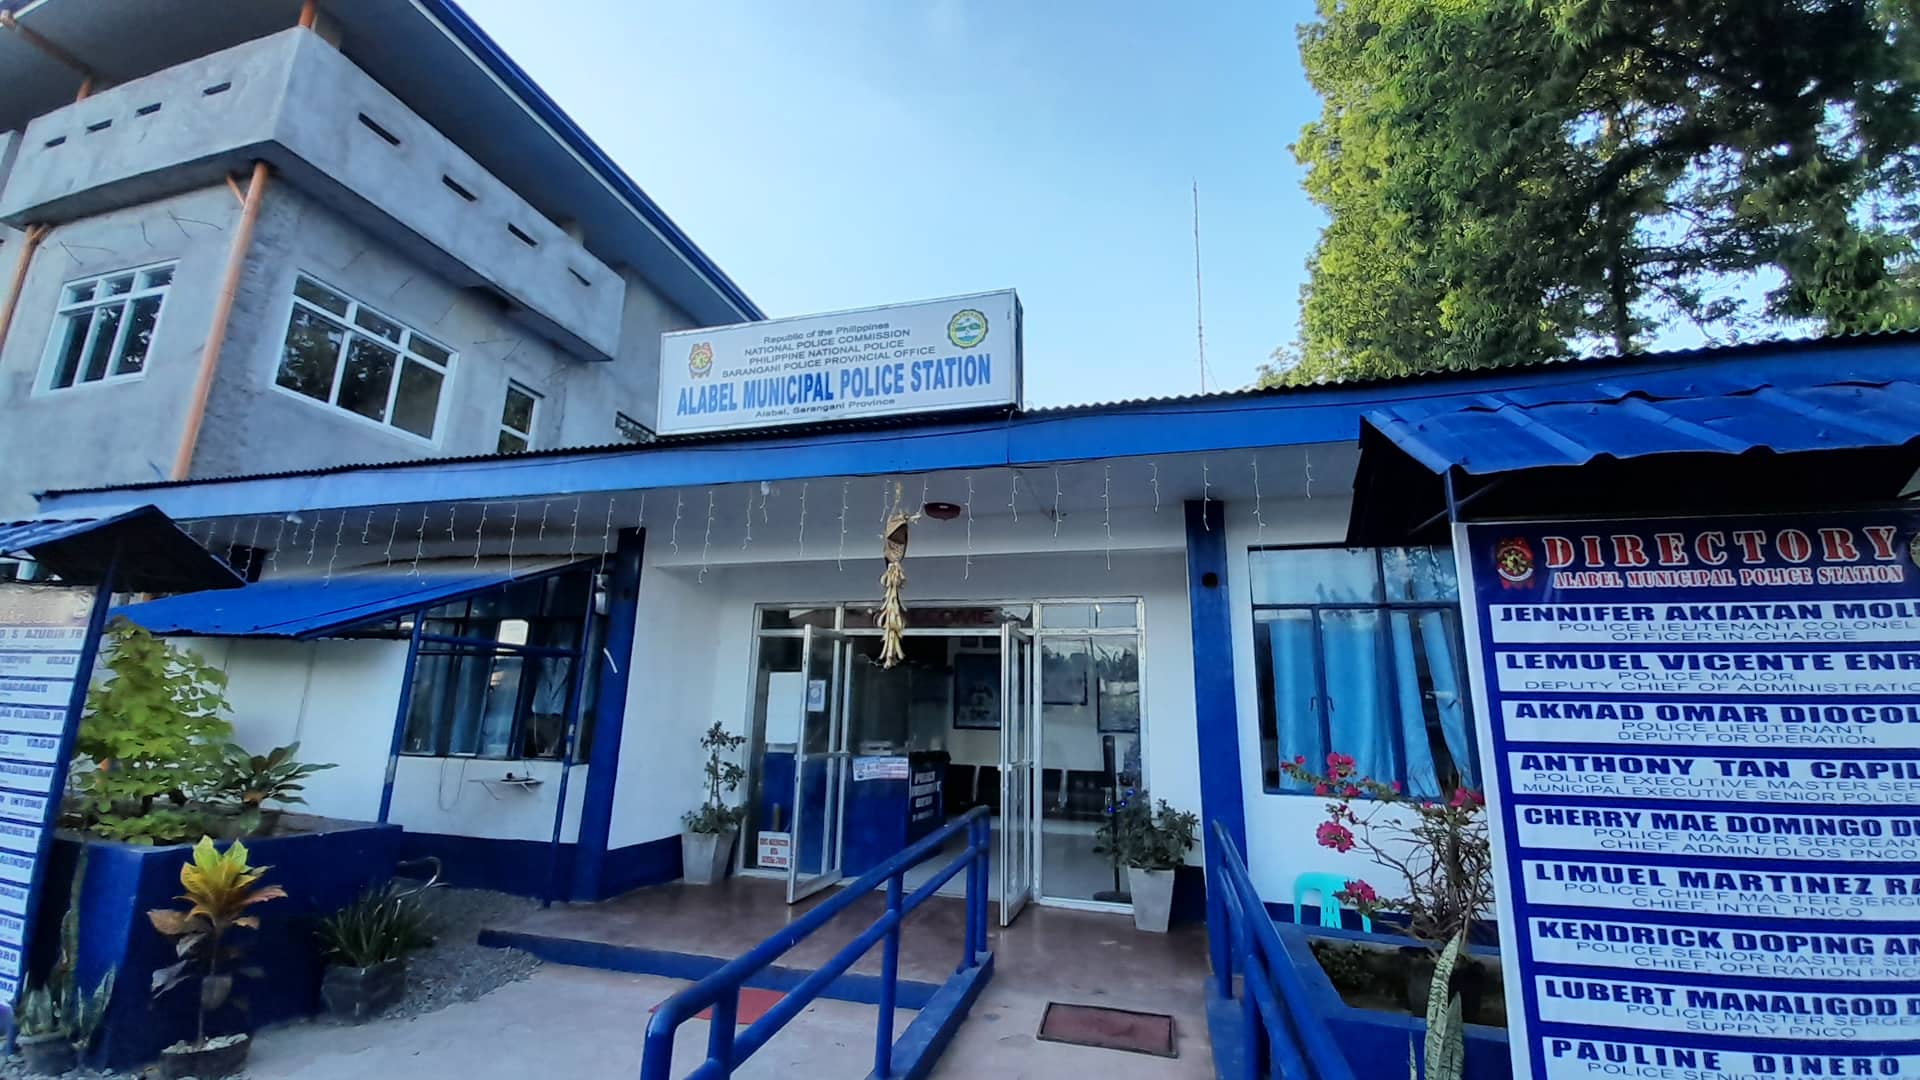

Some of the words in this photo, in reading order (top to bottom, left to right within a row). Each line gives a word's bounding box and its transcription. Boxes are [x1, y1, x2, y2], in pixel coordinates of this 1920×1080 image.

[745, 344, 796, 356] NATIONAL
[797, 338, 835, 349] POLICE
[838, 329, 910, 344] COMMISSION
[764, 332, 804, 345] Republic
[807, 330, 816, 338] of
[818, 329, 833, 337] the
[836, 323, 890, 335] Philippines
[749, 352, 806, 364] PHILIPPINE
[808, 345, 863, 359] NATIONAL
[864, 340, 904, 351] POLICE
[722, 365, 780, 378] SARANGANI
[784, 357, 822, 370] POLICE
[825, 350, 891, 366] PROVINCIAL
[894, 346, 936, 358] OFFICE
[677, 382, 737, 416] ALABEL
[743, 371, 834, 410] MUNICIPAL
[840, 363, 904, 399] POLICE
[911, 353, 991, 393] STATION
[755, 409, 789, 418] Alabel,
[793, 402, 845, 415] Sarangani
[848, 398, 896, 408] Province
[1542, 526, 1897, 567] DIRECTORY
[1553, 572, 1624, 588] ALABEL
[1627, 569, 1737, 588] MUNICIPAL
[1740, 567, 1813, 586] POLICE
[1817, 565, 1904, 584] STATION
[1501, 606, 1654, 622] JENNIFER
[1666, 604, 1823, 621] AKIATAN
[1559, 623, 1641, 631] POLICE
[1648, 622, 1794, 631] LIEUTENANT
[1803, 620, 1919, 630] COLONEL
[1611, 631, 1857, 641] OFFICER-IN-CHARGE
[1506, 654, 1649, 670] LEMUEL
[1657, 654, 1834, 671] VICENTE
[1618, 672, 1701, 681] POLICE
[1711, 672, 1795, 681] MAJOR
[1525, 681, 1613, 690] DEPUTY
[1621, 682, 1689, 691] CHIEF
[1699, 683, 1729, 692] OF
[1515, 703, 1644, 720] AKMAD
[1656, 705, 1768, 722] OMAR
[1618, 732, 1698, 741] DEPUTY
[1705, 733, 1748, 743] FOR
[1755, 734, 1876, 744] OPERATION
[1622, 723, 1706, 732] POLICE
[1716, 724, 1866, 734] LIEUTENANT
[1520, 754, 1694, 775] ANTHONY
[1713, 760, 1790, 778] TAN
[1534, 773, 1619, 783] POLICE
[1624, 775, 1758, 789] EXECUTIVE
[1768, 781, 1869, 790] MASTER
[1523, 783, 1626, 795] MUNICIPAL
[1632, 787, 1748, 799] EXECUTIVE
[1756, 791, 1835, 801] SENIOR
[1843, 792, 1917, 802] POLICE
[1524, 808, 1641, 828] CHERRY
[1651, 813, 1718, 831] MAE
[1726, 815, 1882, 836] DOMINGO
[1594, 828, 1680, 840] POLICE
[1688, 833, 1789, 845] MASTER
[1682, 844, 1766, 856] ADMIN/
[1776, 847, 1841, 858] DLOS
[1850, 849, 1918, 859] PNCO
[1536, 864, 1666, 886] LIMUEL
[1678, 871, 1872, 895] MARTINEZ
[1564, 883, 1649, 897] POLICE
[1658, 888, 1729, 899] CHIEF
[1739, 893, 1840, 905] MASTER
[1717, 903, 1785, 916] INTEL
[1794, 907, 1863, 917] PNCO
[1537, 920, 1723, 949] KENDRICK
[1732, 933, 1874, 955] DOPING
[1576, 942, 1662, 956] POLICE
[1672, 948, 1765, 962] SENIOR
[1775, 955, 1873, 966] MASTER
[1720, 962, 1861, 977] OPERATION
[1545, 980, 1675, 1006] LUBERT
[1686, 990, 1897, 1016] MANALIGOD
[1627, 1004, 1715, 1019] POLICE
[1724, 1011, 1824, 1025] MASTER
[1687, 1021, 1778, 1034] SUPPLY
[1790, 1027, 1857, 1038] PNCO
[1552, 1039, 1722, 1071] PAULINE
[1753, 1055, 1900, 1075] DINERO
[1588, 1062, 1674, 1079] POLICE
